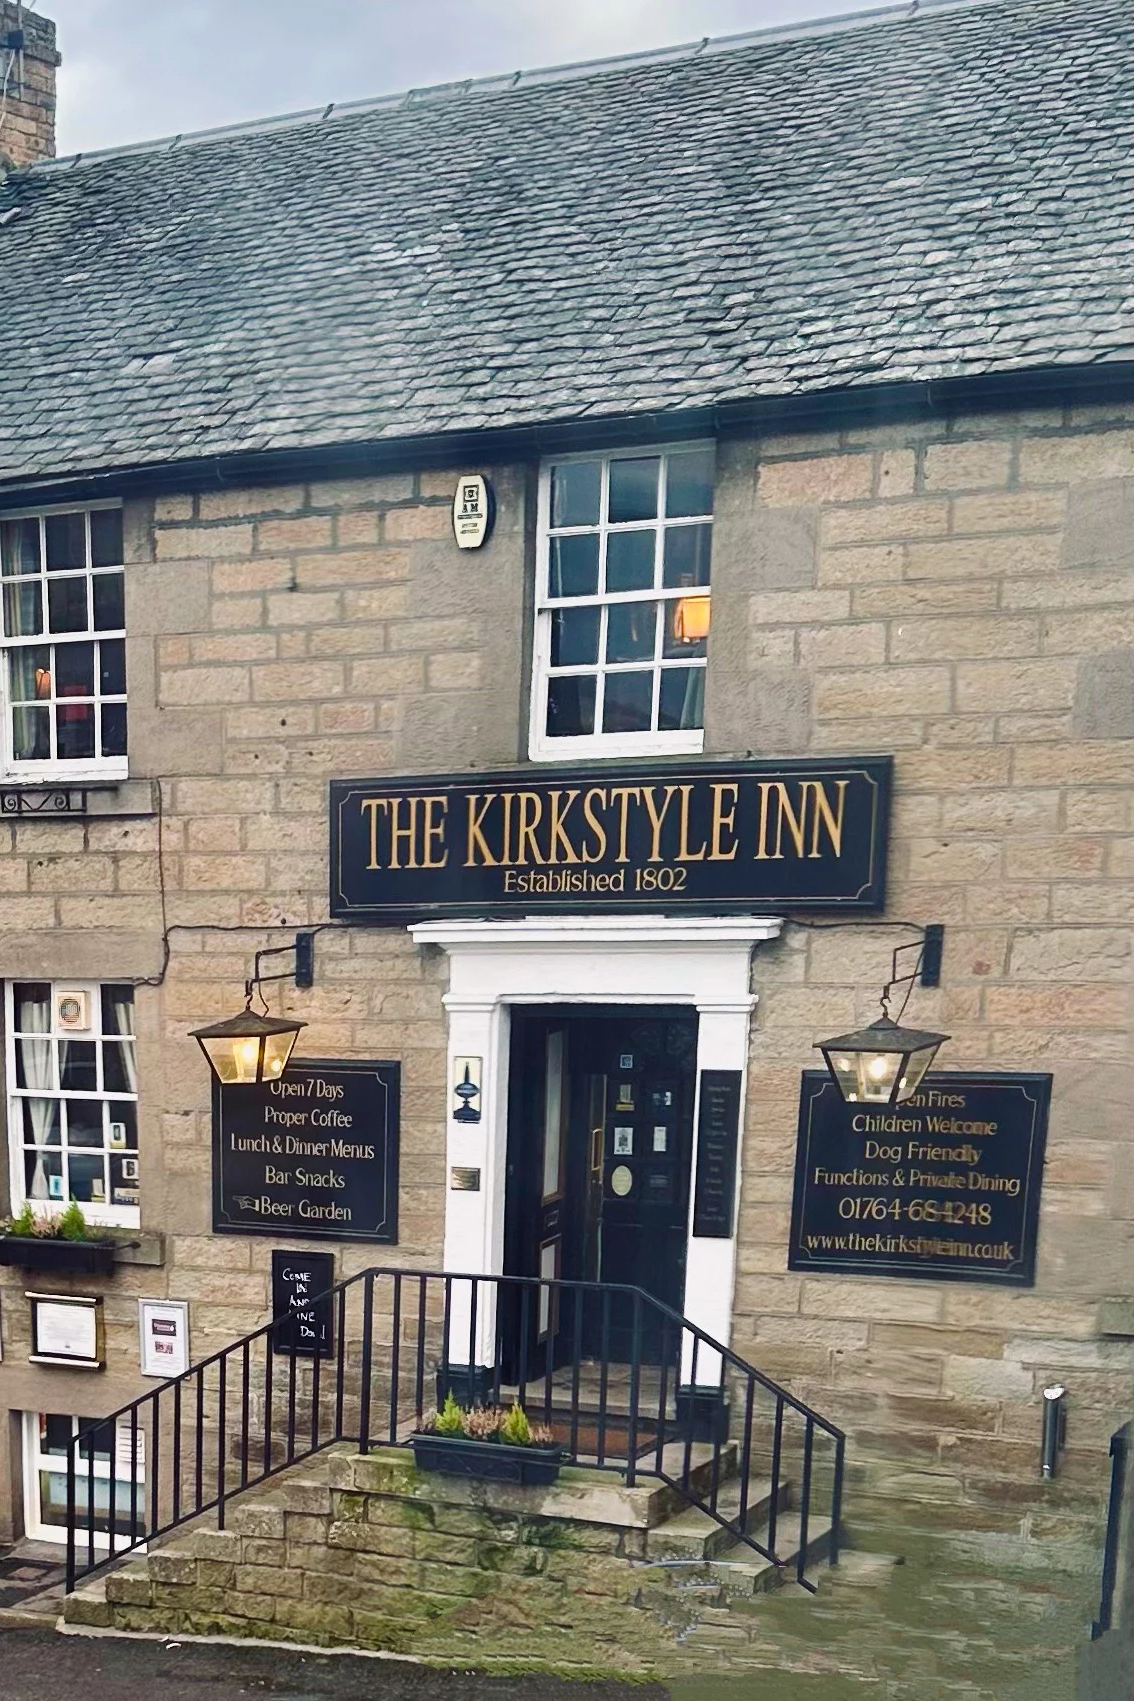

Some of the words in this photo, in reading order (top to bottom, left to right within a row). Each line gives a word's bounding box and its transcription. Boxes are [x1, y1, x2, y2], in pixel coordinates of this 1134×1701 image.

[360, 796, 449, 870] THE
[463, 783, 740, 869] KIRKSTYLE
[754, 780, 850, 860] INN
[503, 869, 624, 894] Established
[635, 867, 687, 893] 1802
[270, 1081, 305, 1099] Open
[306, 1079, 315, 1097] 7
[316, 1079, 344, 1102] Days
[928, 1091, 966, 1109] Fires
[264, 1105, 308, 1128] Proper
[311, 1108, 353, 1128] Coffee
[852, 1115, 922, 1133] Children
[926, 1116, 998, 1136] Welcome
[231, 1133, 270, 1153] Lunch
[272, 1134, 283, 1154] &
[285, 1136, 330, 1157] Dinner
[330, 1139, 375, 1160] Menus
[865, 1140, 902, 1163] Dog
[907, 1142, 982, 1167] Friendly
[265, 1166, 292, 1185] Bar
[295, 1168, 346, 1188] Snacks
[814, 1168, 889, 1187] Functions
[892, 1169, 906, 1187] &
[909, 1169, 966, 1189] Private
[968, 1174, 1021, 1196] Dining
[261, 1195, 295, 1216] Beer
[299, 1200, 352, 1221] Garden
